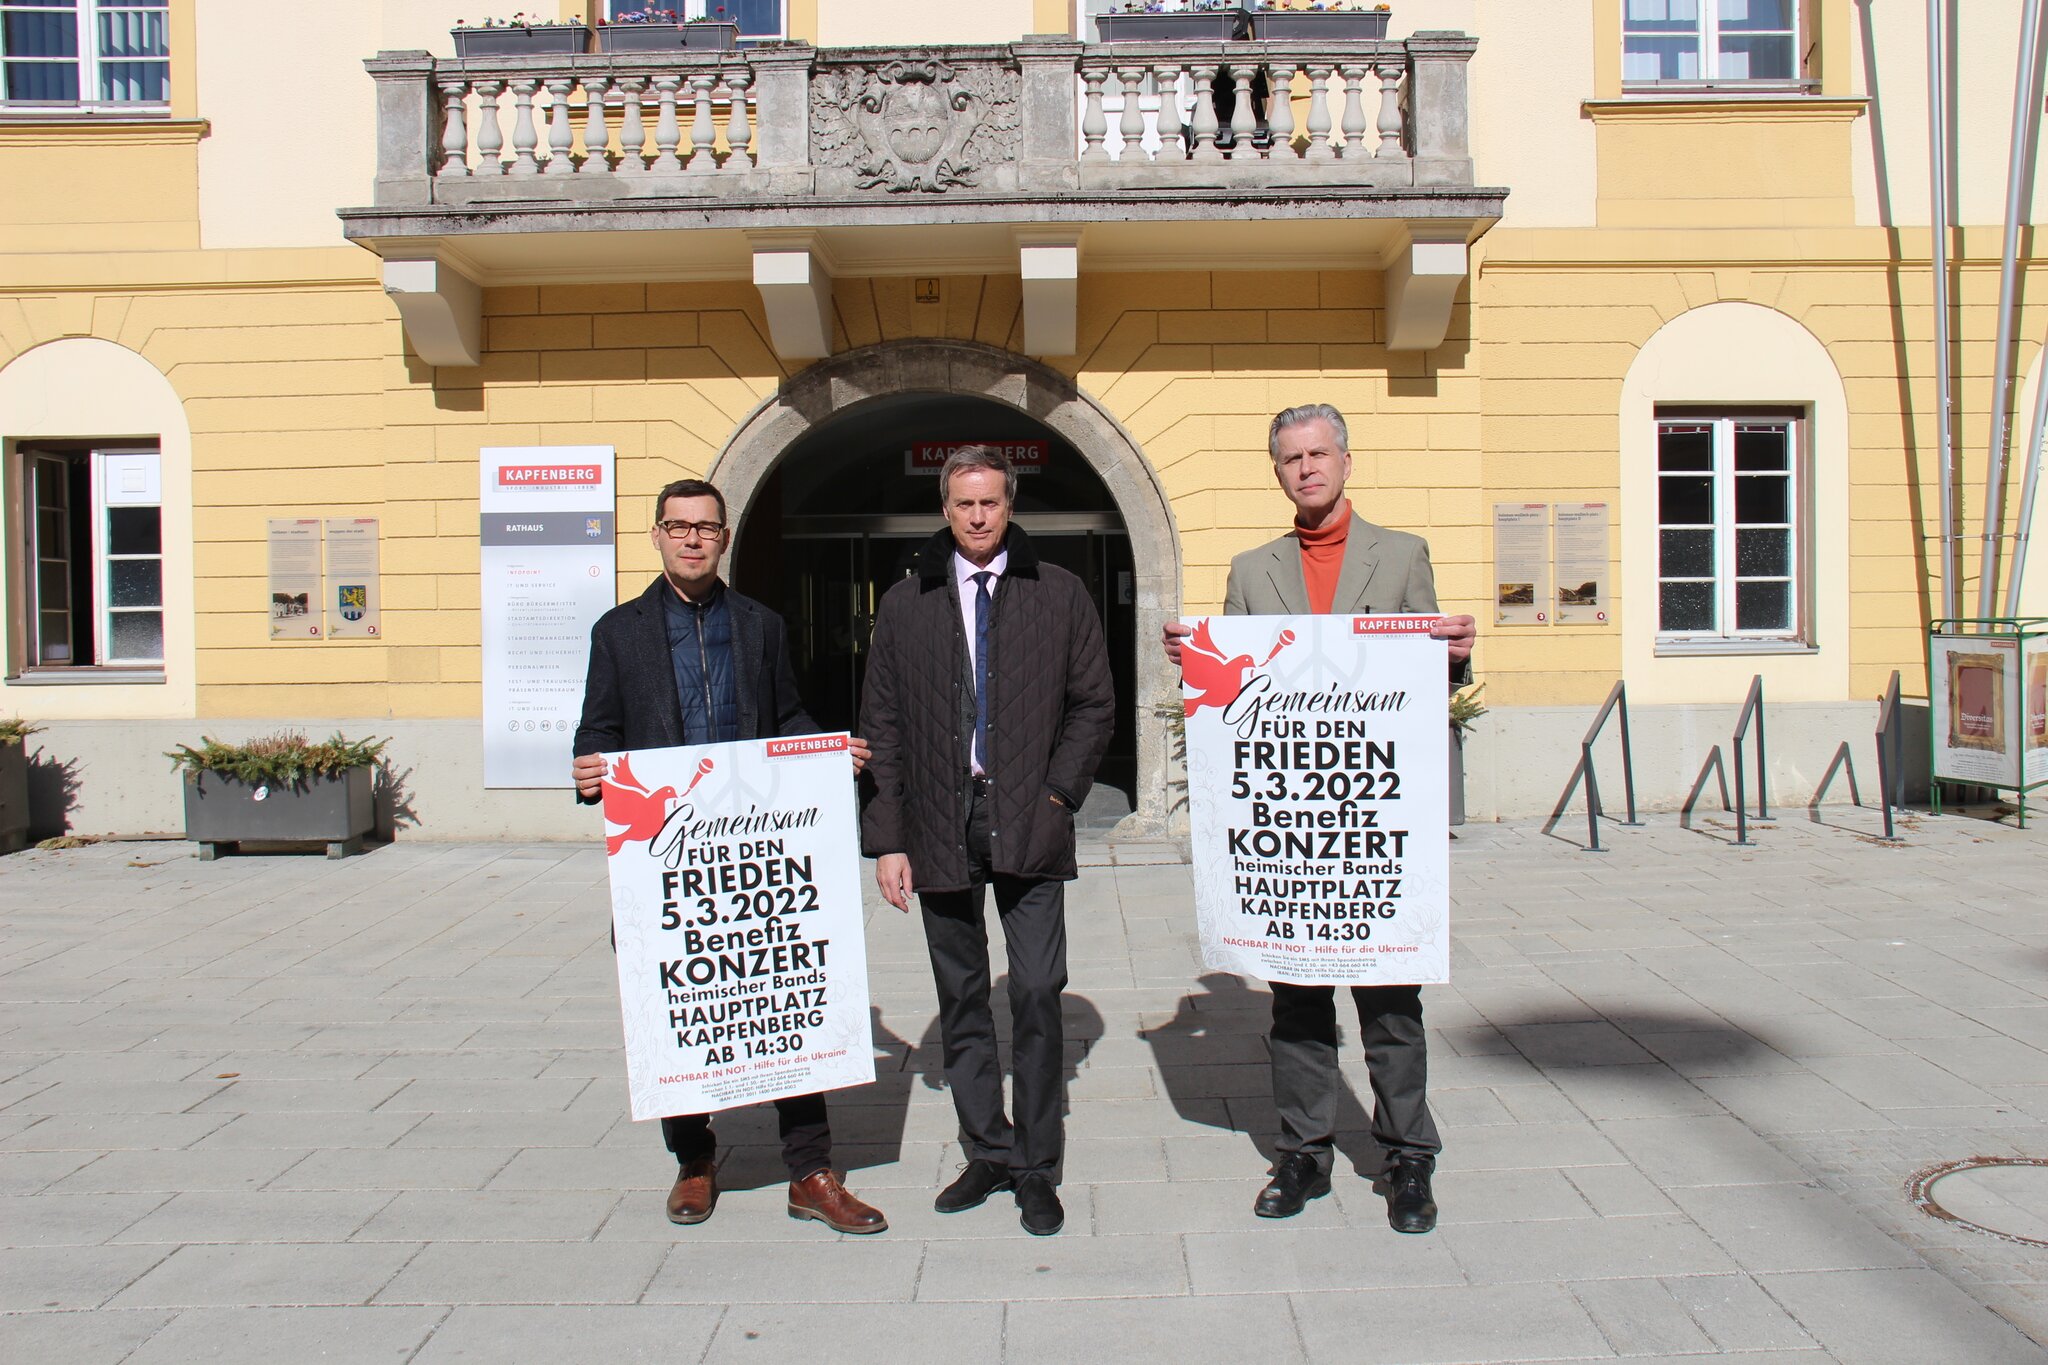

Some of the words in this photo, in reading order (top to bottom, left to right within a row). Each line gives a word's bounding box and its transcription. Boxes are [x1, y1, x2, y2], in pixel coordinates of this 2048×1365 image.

[922, 446, 1039, 460] KAPERG
[506, 468, 594, 480] KAPFENBERG
[1222, 674, 1411, 739] Gemeinsam
[1261, 715, 1306, 738] FÜR
[1316, 720, 1366, 738] DEN
[772, 738, 842, 753] KAPFENBERG
[1234, 741, 1395, 770] FRIEDEN
[1231, 771, 1401, 801] 5.3.2022
[1252, 800, 1378, 828] Benefiz
[648, 804, 823, 869] Gemeinsam
[688, 842, 730, 865] FÜR
[739, 838, 784, 859] DEN
[1228, 828, 1408, 859] KONZERT
[662, 856, 812, 900] FRIEDEN
[1234, 856, 1335, 876] heimischer
[1343, 859, 1402, 875] Bands
[1235, 876, 1402, 899] HAUPTPLATZ
[661, 884, 819, 930] 5.3.2022
[1241, 898, 1396, 920] KAPFENBERG
[684, 917, 801, 955] Benefiz
[1223, 937, 1269, 949] NACHBAR
[1272, 942, 1282, 950] IN
[1285, 944, 1306, 954] NOT
[1315, 945, 1338, 954] Hilfe
[1342, 945, 1357, 954] für
[1360, 945, 1374, 954] die
[1378, 944, 1418, 953] Ukraine
[1265, 921, 1295, 939] AB
[1306, 922, 1371, 941] 14:30
[660, 940, 829, 989] KONZERT
[668, 980, 766, 1004] heimischer
[773, 969, 826, 990] Bands
[670, 987, 827, 1028] HAUPTPLATZ
[677, 1010, 824, 1048] KAPFENBERG
[705, 1046, 735, 1066] AB
[744, 1034, 803, 1058] 14:30
[659, 1072, 709, 1085] NACHBAR
[712, 1068, 722, 1078] IN
[726, 1065, 746, 1076] NOT
[754, 1061, 775, 1071] Hilfe
[778, 1058, 791, 1066] für
[794, 1054, 808, 1064] die
[811, 1049, 847, 1061] Ukraine
